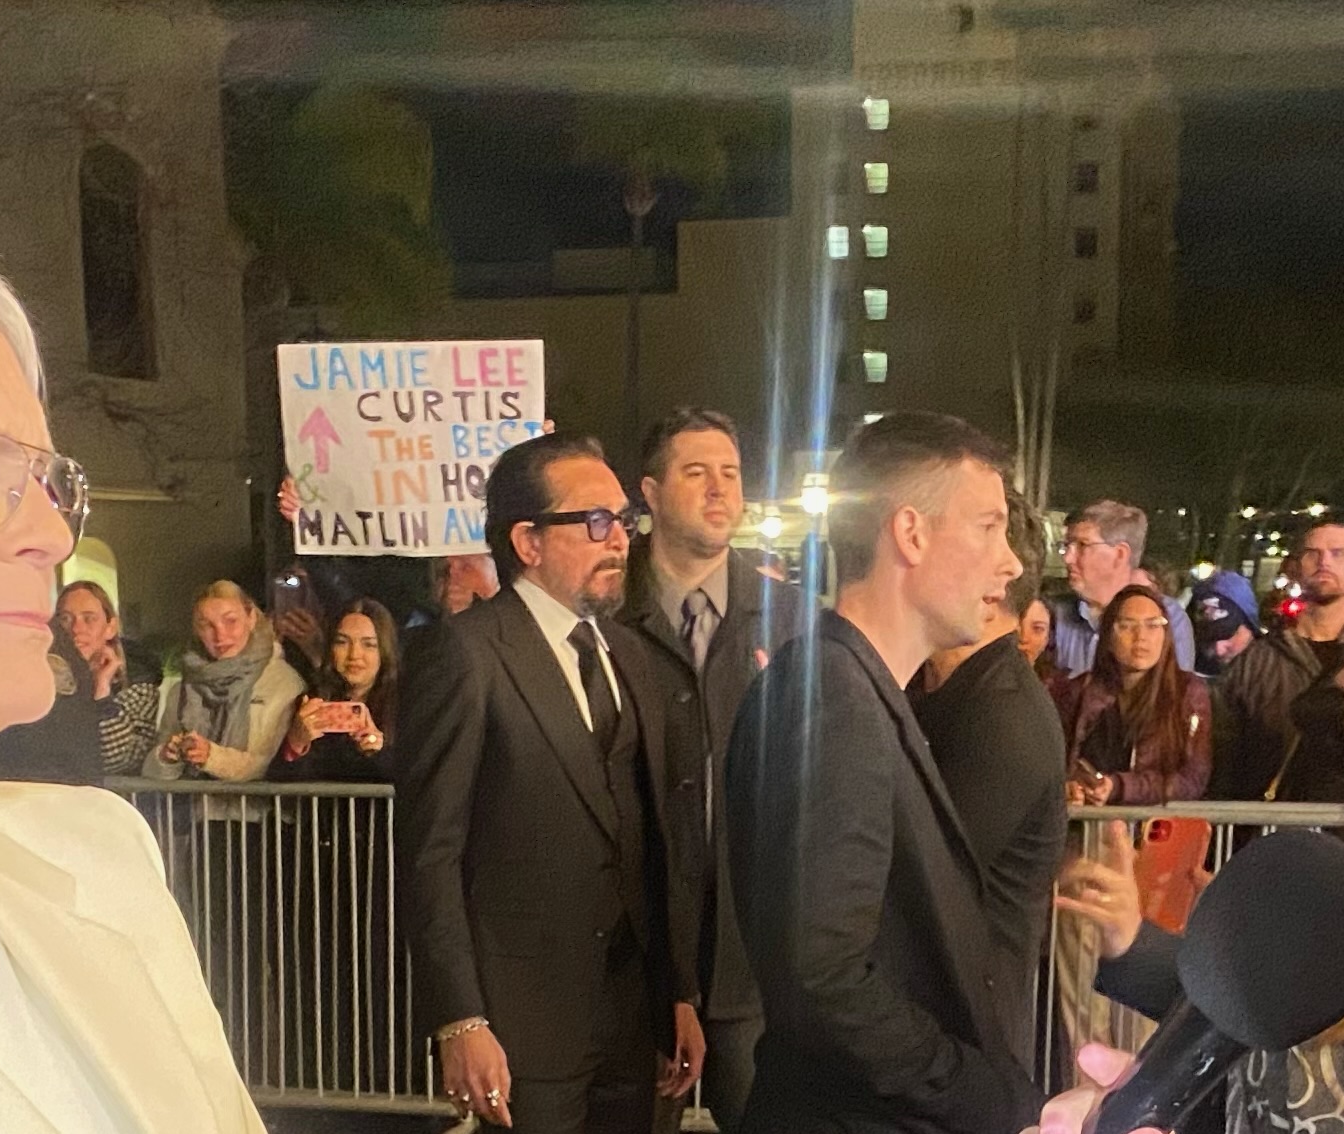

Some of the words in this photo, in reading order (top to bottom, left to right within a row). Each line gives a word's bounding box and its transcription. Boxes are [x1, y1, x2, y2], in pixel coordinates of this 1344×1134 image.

[293, 347, 432, 391] JAMIE
[451, 346, 528, 387] LEE
[357, 390, 523, 423] CURTIS
[367, 429, 434, 463] THE
[452, 421, 541, 458] BEST
[372, 465, 432, 506] IN
[440, 462, 494, 502] HO
[298, 509, 429, 548] MATLIN
